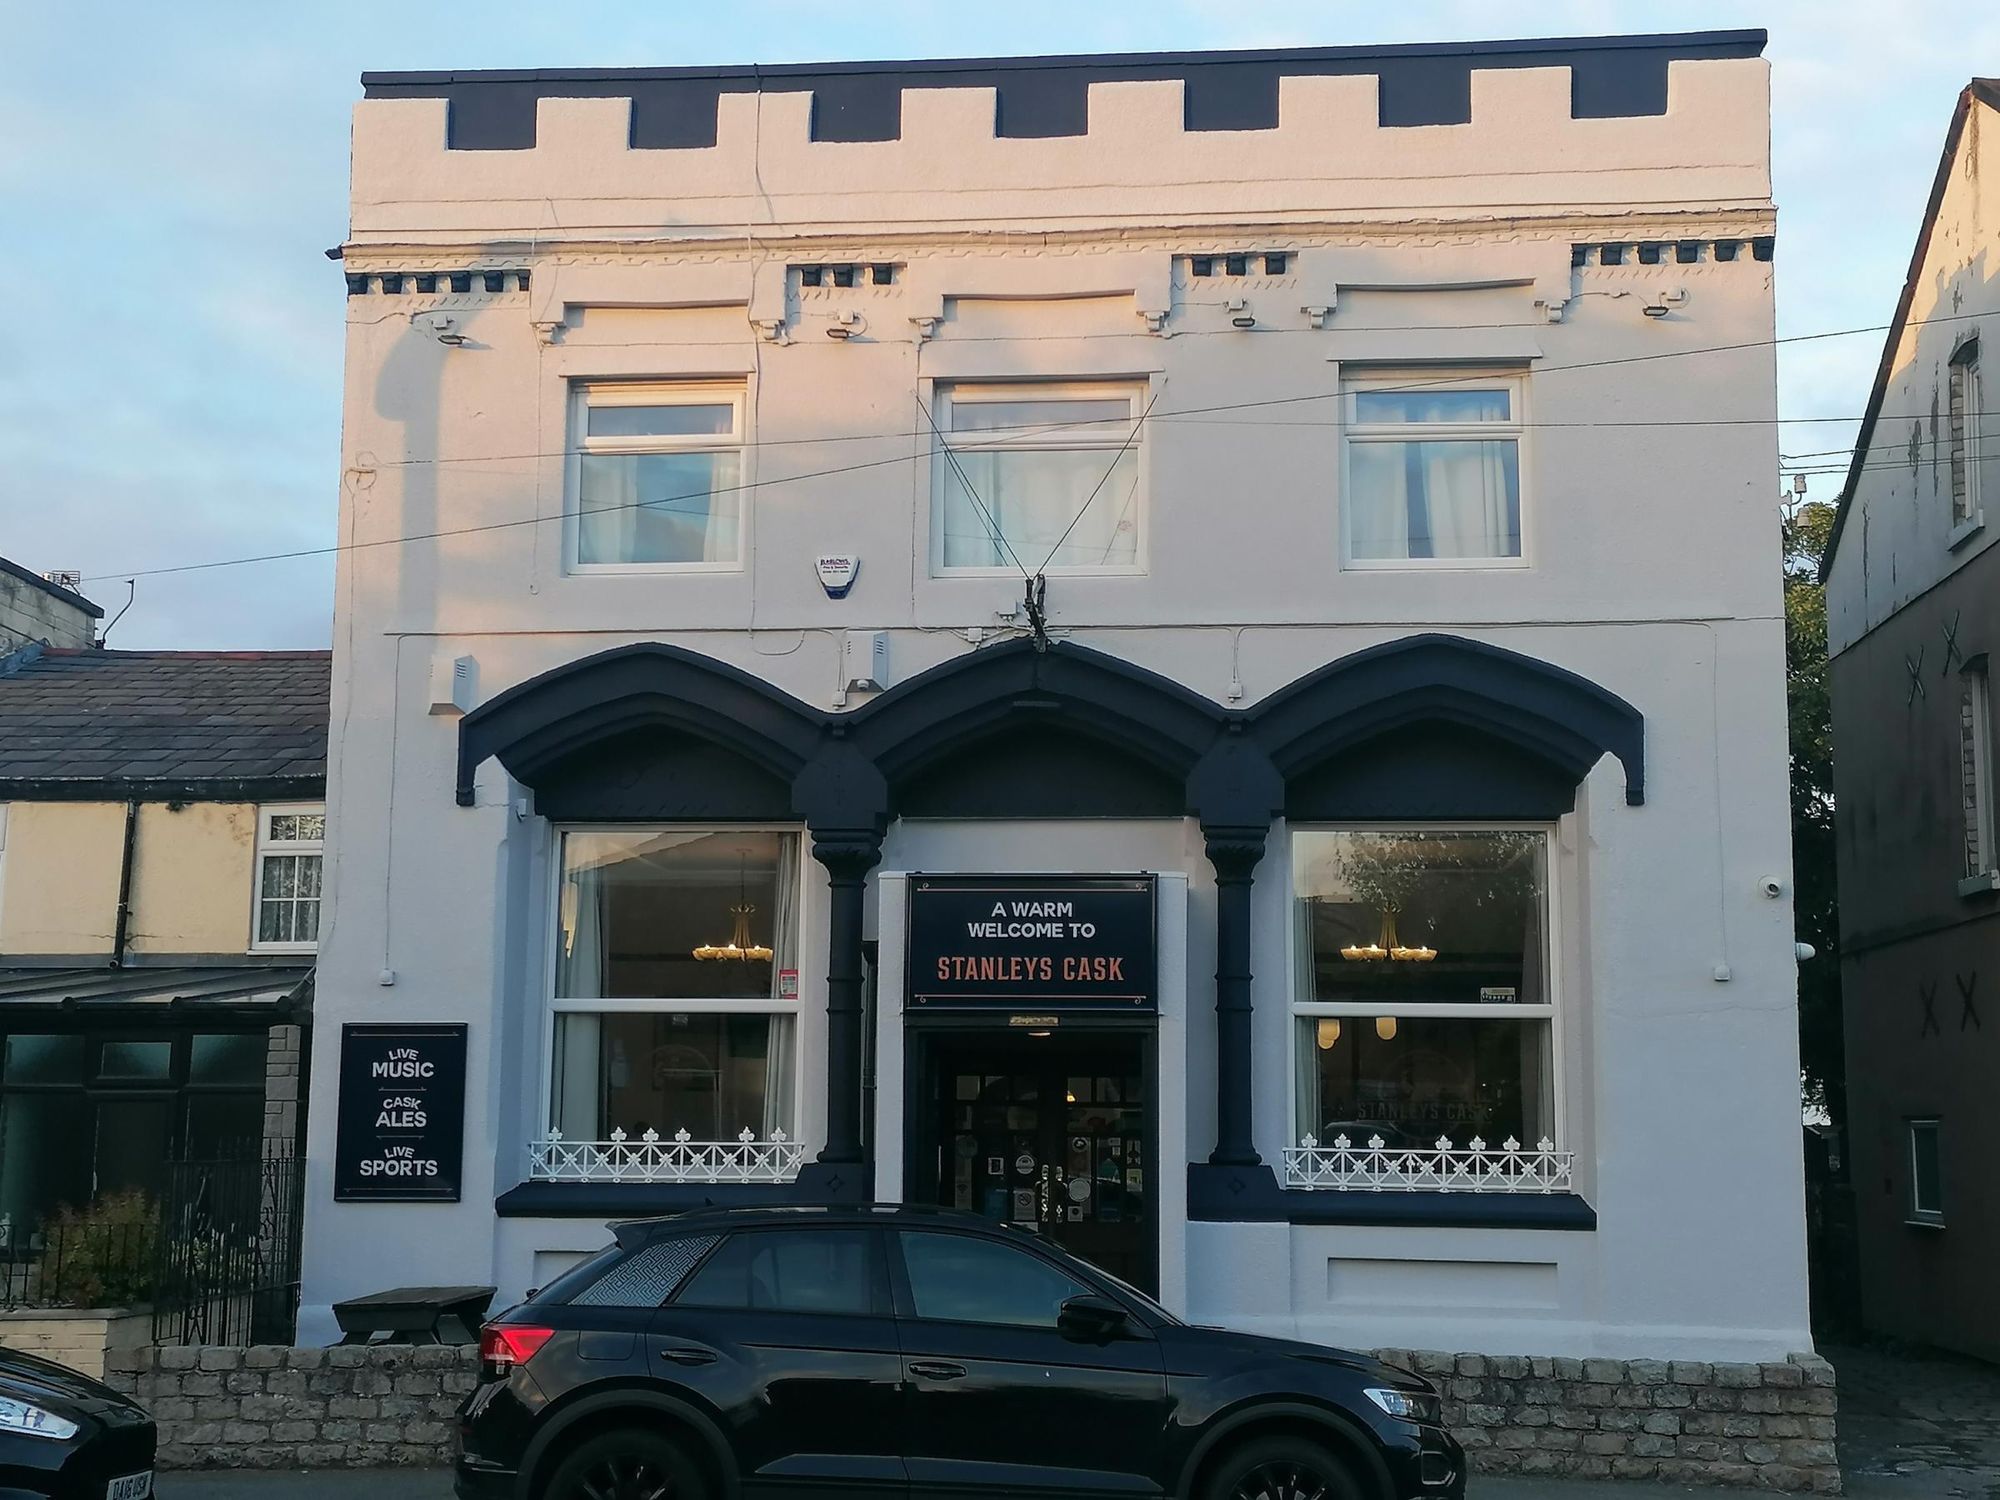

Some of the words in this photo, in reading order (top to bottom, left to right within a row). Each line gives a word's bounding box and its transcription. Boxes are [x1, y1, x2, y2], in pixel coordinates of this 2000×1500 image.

[991, 902, 1007, 918] A
[1011, 902, 1073, 918] WARM
[968, 922, 1064, 938] WELCOME
[1069, 923, 1096, 938] TO
[937, 957, 1053, 981] STANLEYS
[1063, 957, 1124, 981] CASK
[388, 1048, 419, 1061] LIVE
[372, 1062, 434, 1078] MUSIC
[383, 1096, 421, 1110] CASK
[1358, 1102, 1439, 1120] STANLEYS
[375, 1111, 427, 1128] ALES
[384, 1146, 415, 1159] LIVE
[359, 1159, 438, 1176] SPORTS
